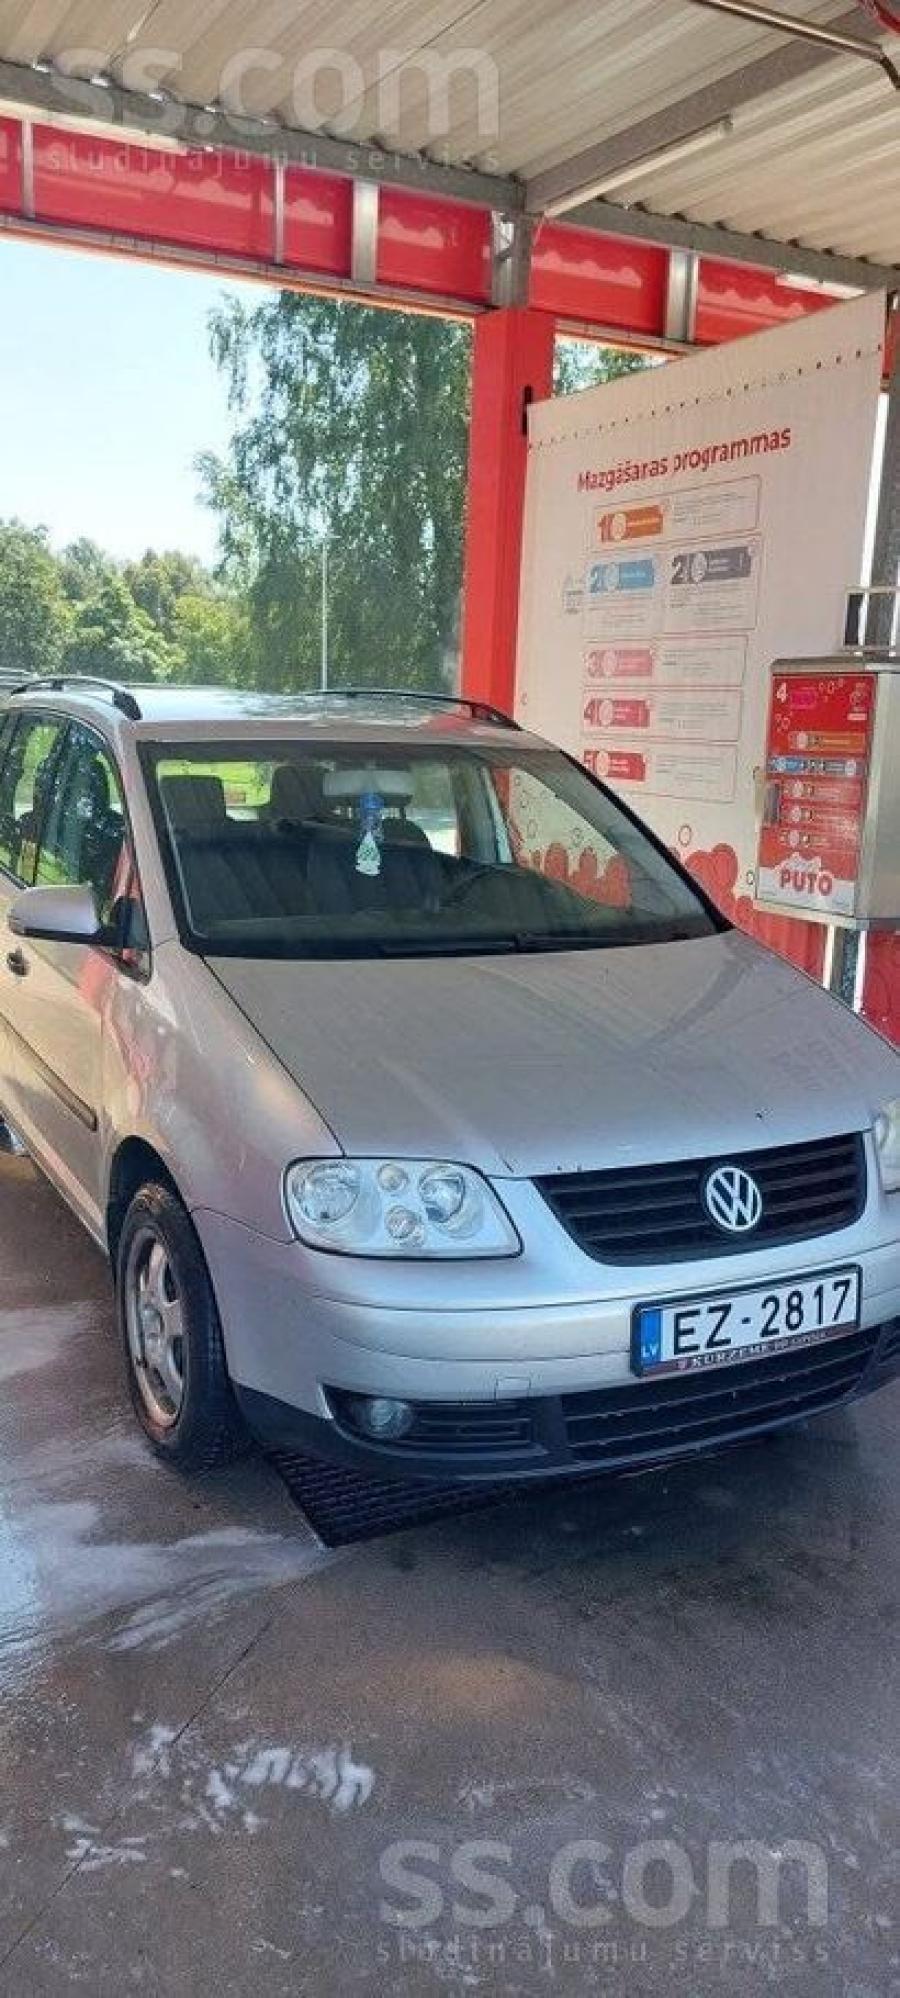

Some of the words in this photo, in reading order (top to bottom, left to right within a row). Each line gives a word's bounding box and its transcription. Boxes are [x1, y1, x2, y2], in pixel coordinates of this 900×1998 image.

[674, 427, 791, 472] programmas
[776, 682, 787, 703] 4
[780, 868, 833, 897] PUTO
[673, 1279, 851, 1356] EZ-2817
[641, 1345, 657, 1358] LV
